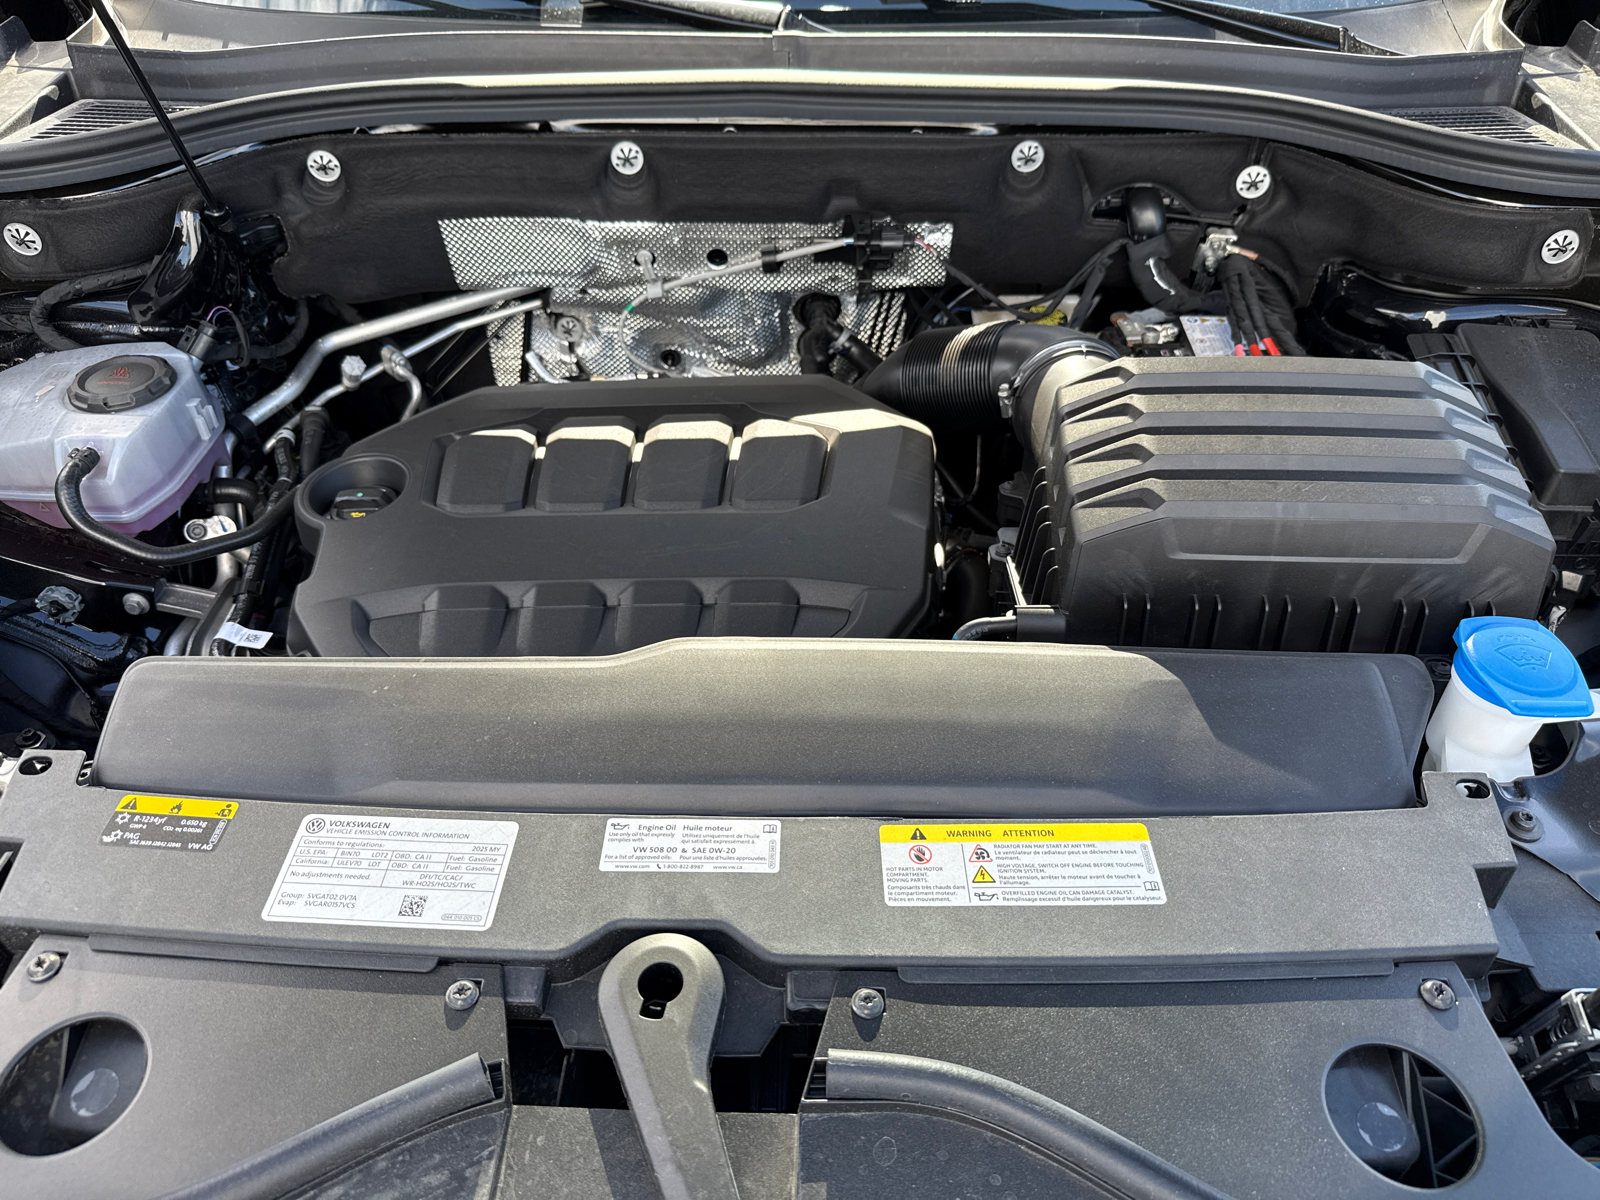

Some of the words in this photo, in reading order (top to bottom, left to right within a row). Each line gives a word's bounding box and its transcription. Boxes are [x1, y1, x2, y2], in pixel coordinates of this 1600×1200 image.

[134, 815, 168, 825] R-1234yf
[199, 820, 208, 828] kg
[329, 820, 391, 829] VOLKSWAGEN
[638, 824, 664, 832] Engine
[123, 831, 141, 840] PAG
[354, 829, 387, 837] EMISSION
[388, 830, 420, 838] CONTROL
[421, 831, 471, 840] INFORMATION
[946, 830, 992, 838] WARNING
[1002, 829, 1055, 837] ATTENTION
[188, 842, 201, 850] VW
[303, 839, 335, 847] Conforms
[345, 841, 385, 849] regulations:
[295, 857, 330, 865] California:
[468, 855, 498, 863] Gasoline
[301, 871, 343, 879] adjustments
[344, 872, 371, 880] needed.
[419, 873, 463, 881] DFI/TC/CAC/
[402, 880, 476, 889] WR-HO2S/HO2S/TWC
[280, 892, 304, 900] Group:
[277, 899, 297, 907] Evap:
